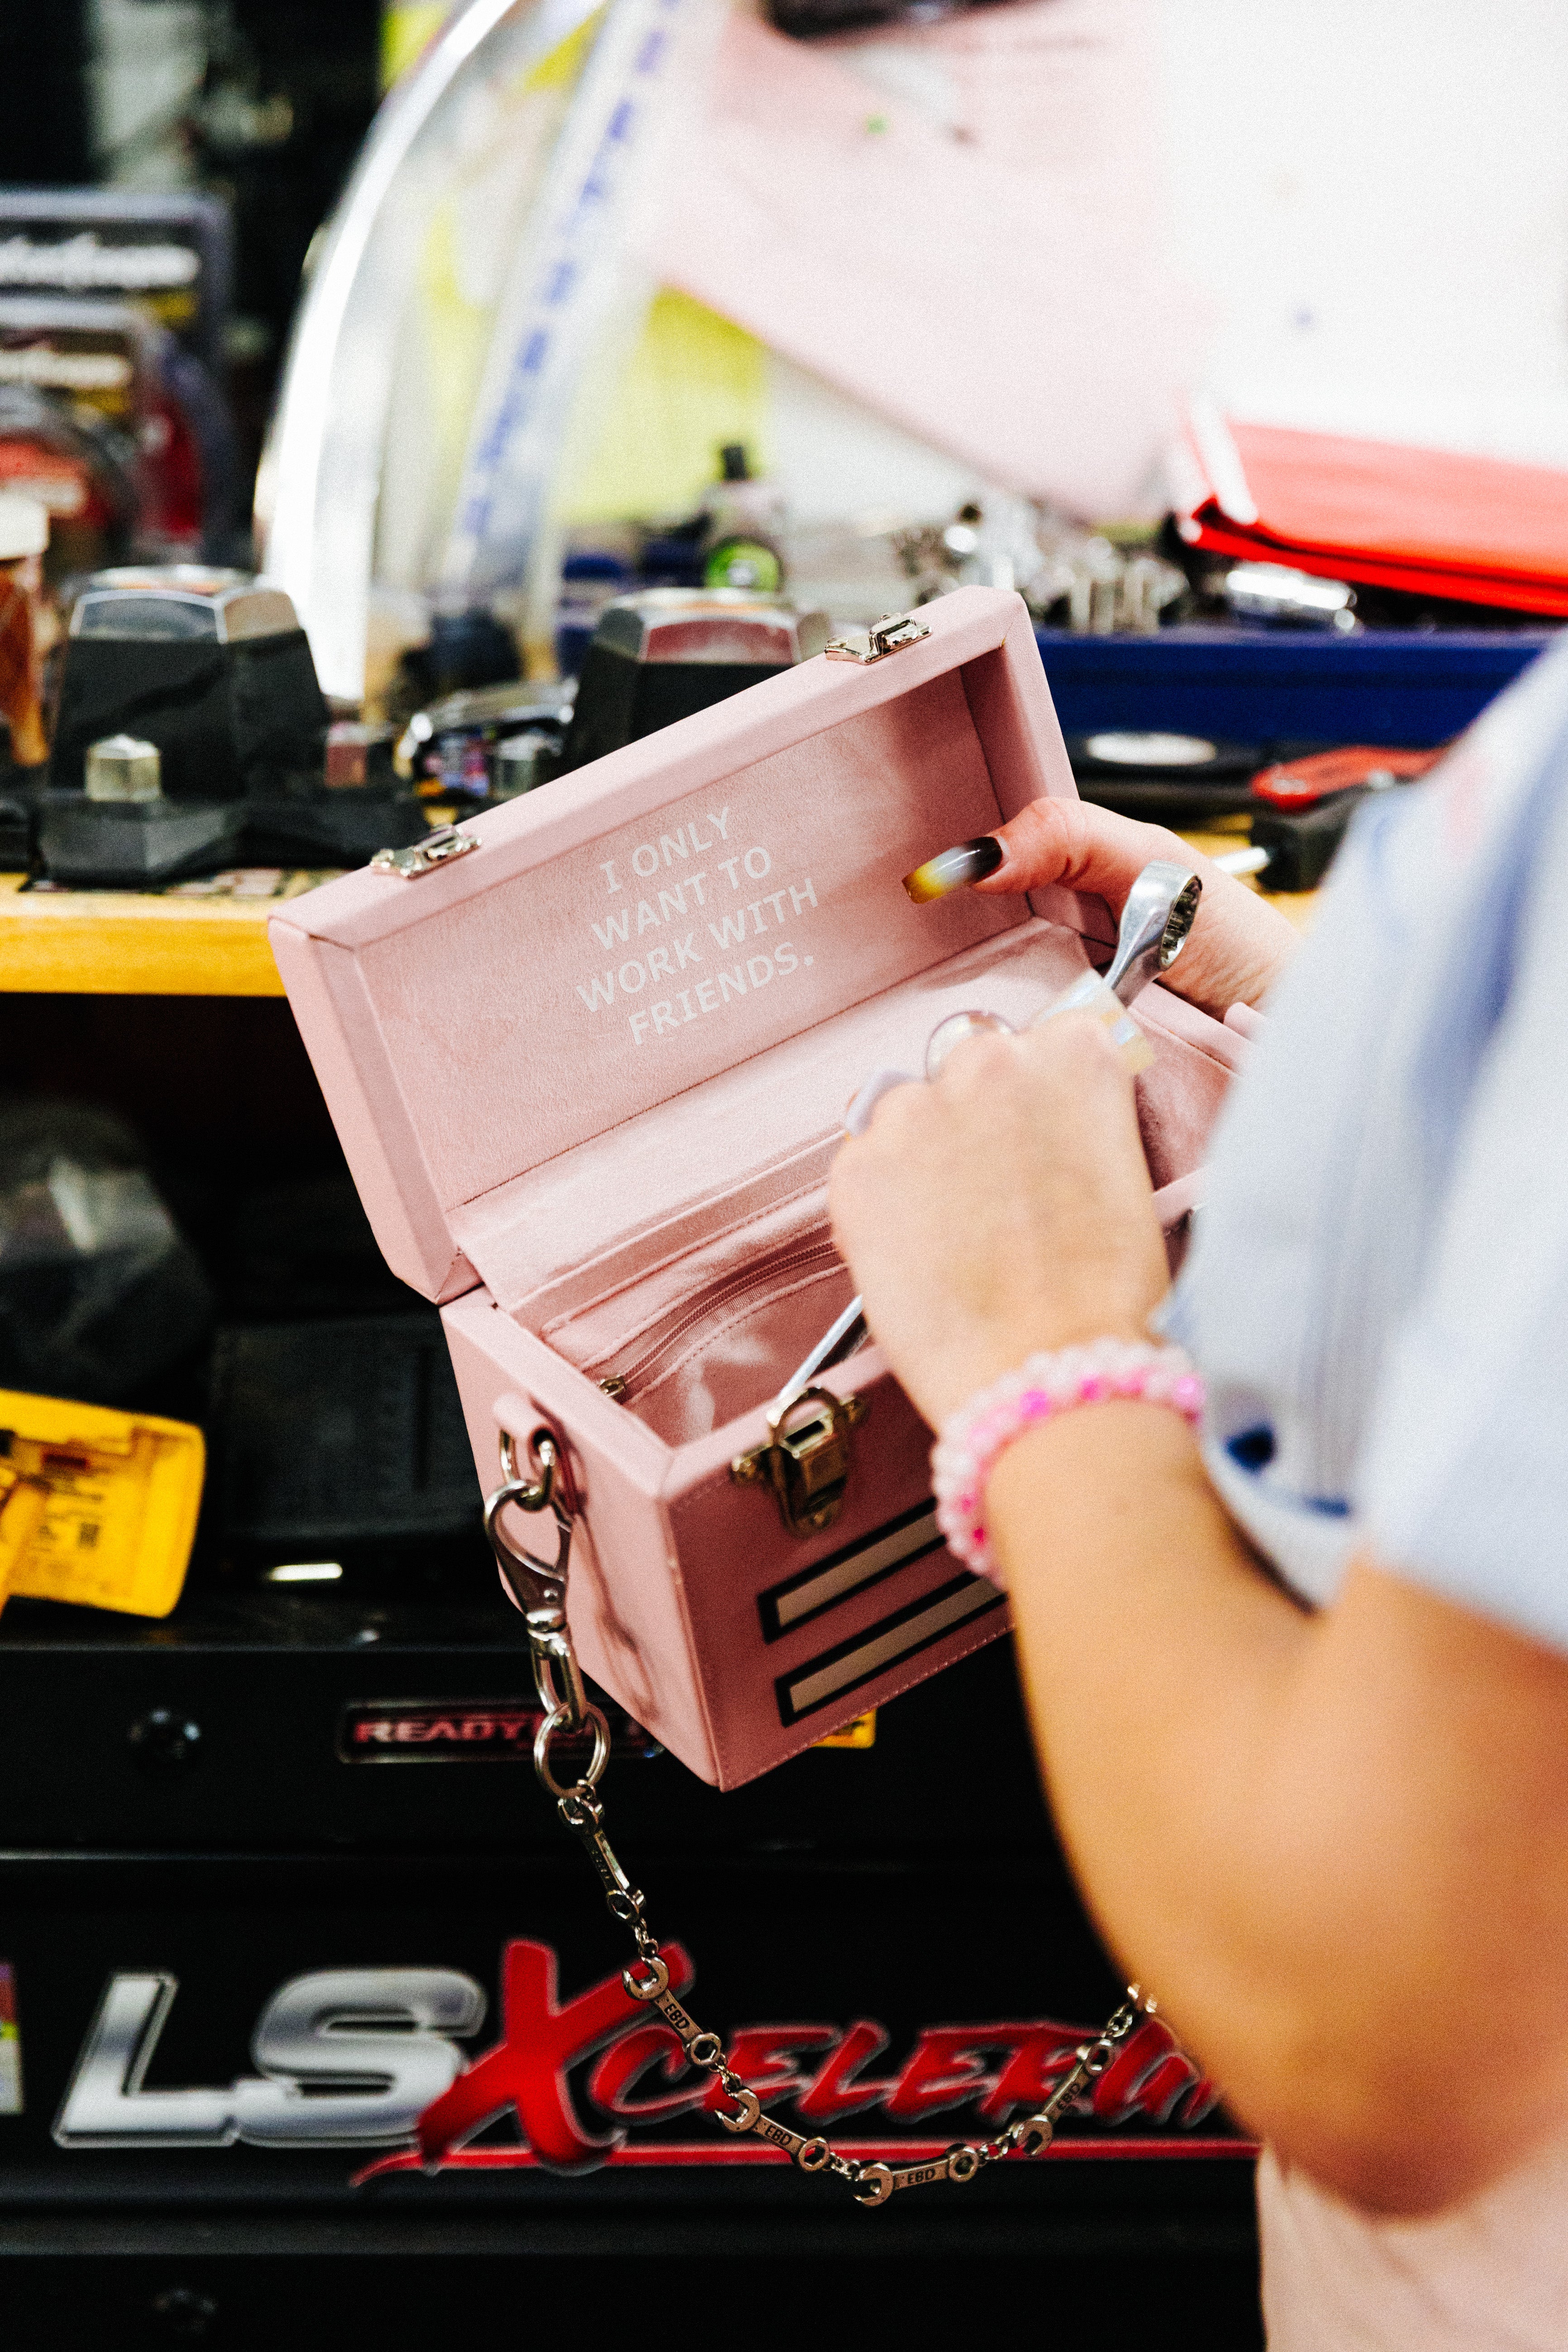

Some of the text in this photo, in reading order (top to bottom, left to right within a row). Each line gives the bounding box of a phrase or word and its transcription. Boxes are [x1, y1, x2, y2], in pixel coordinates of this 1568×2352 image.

[600, 806, 729, 894] I ONLY
[591, 846, 771, 950] WANT TO
[576, 878, 819, 1013] WORK WITH
[627, 942, 814, 1045] FRIENDS.
[664, 2003, 690, 2029] EBD
[765, 2125, 793, 2146] EBD
[907, 2168, 936, 2185] EBD
